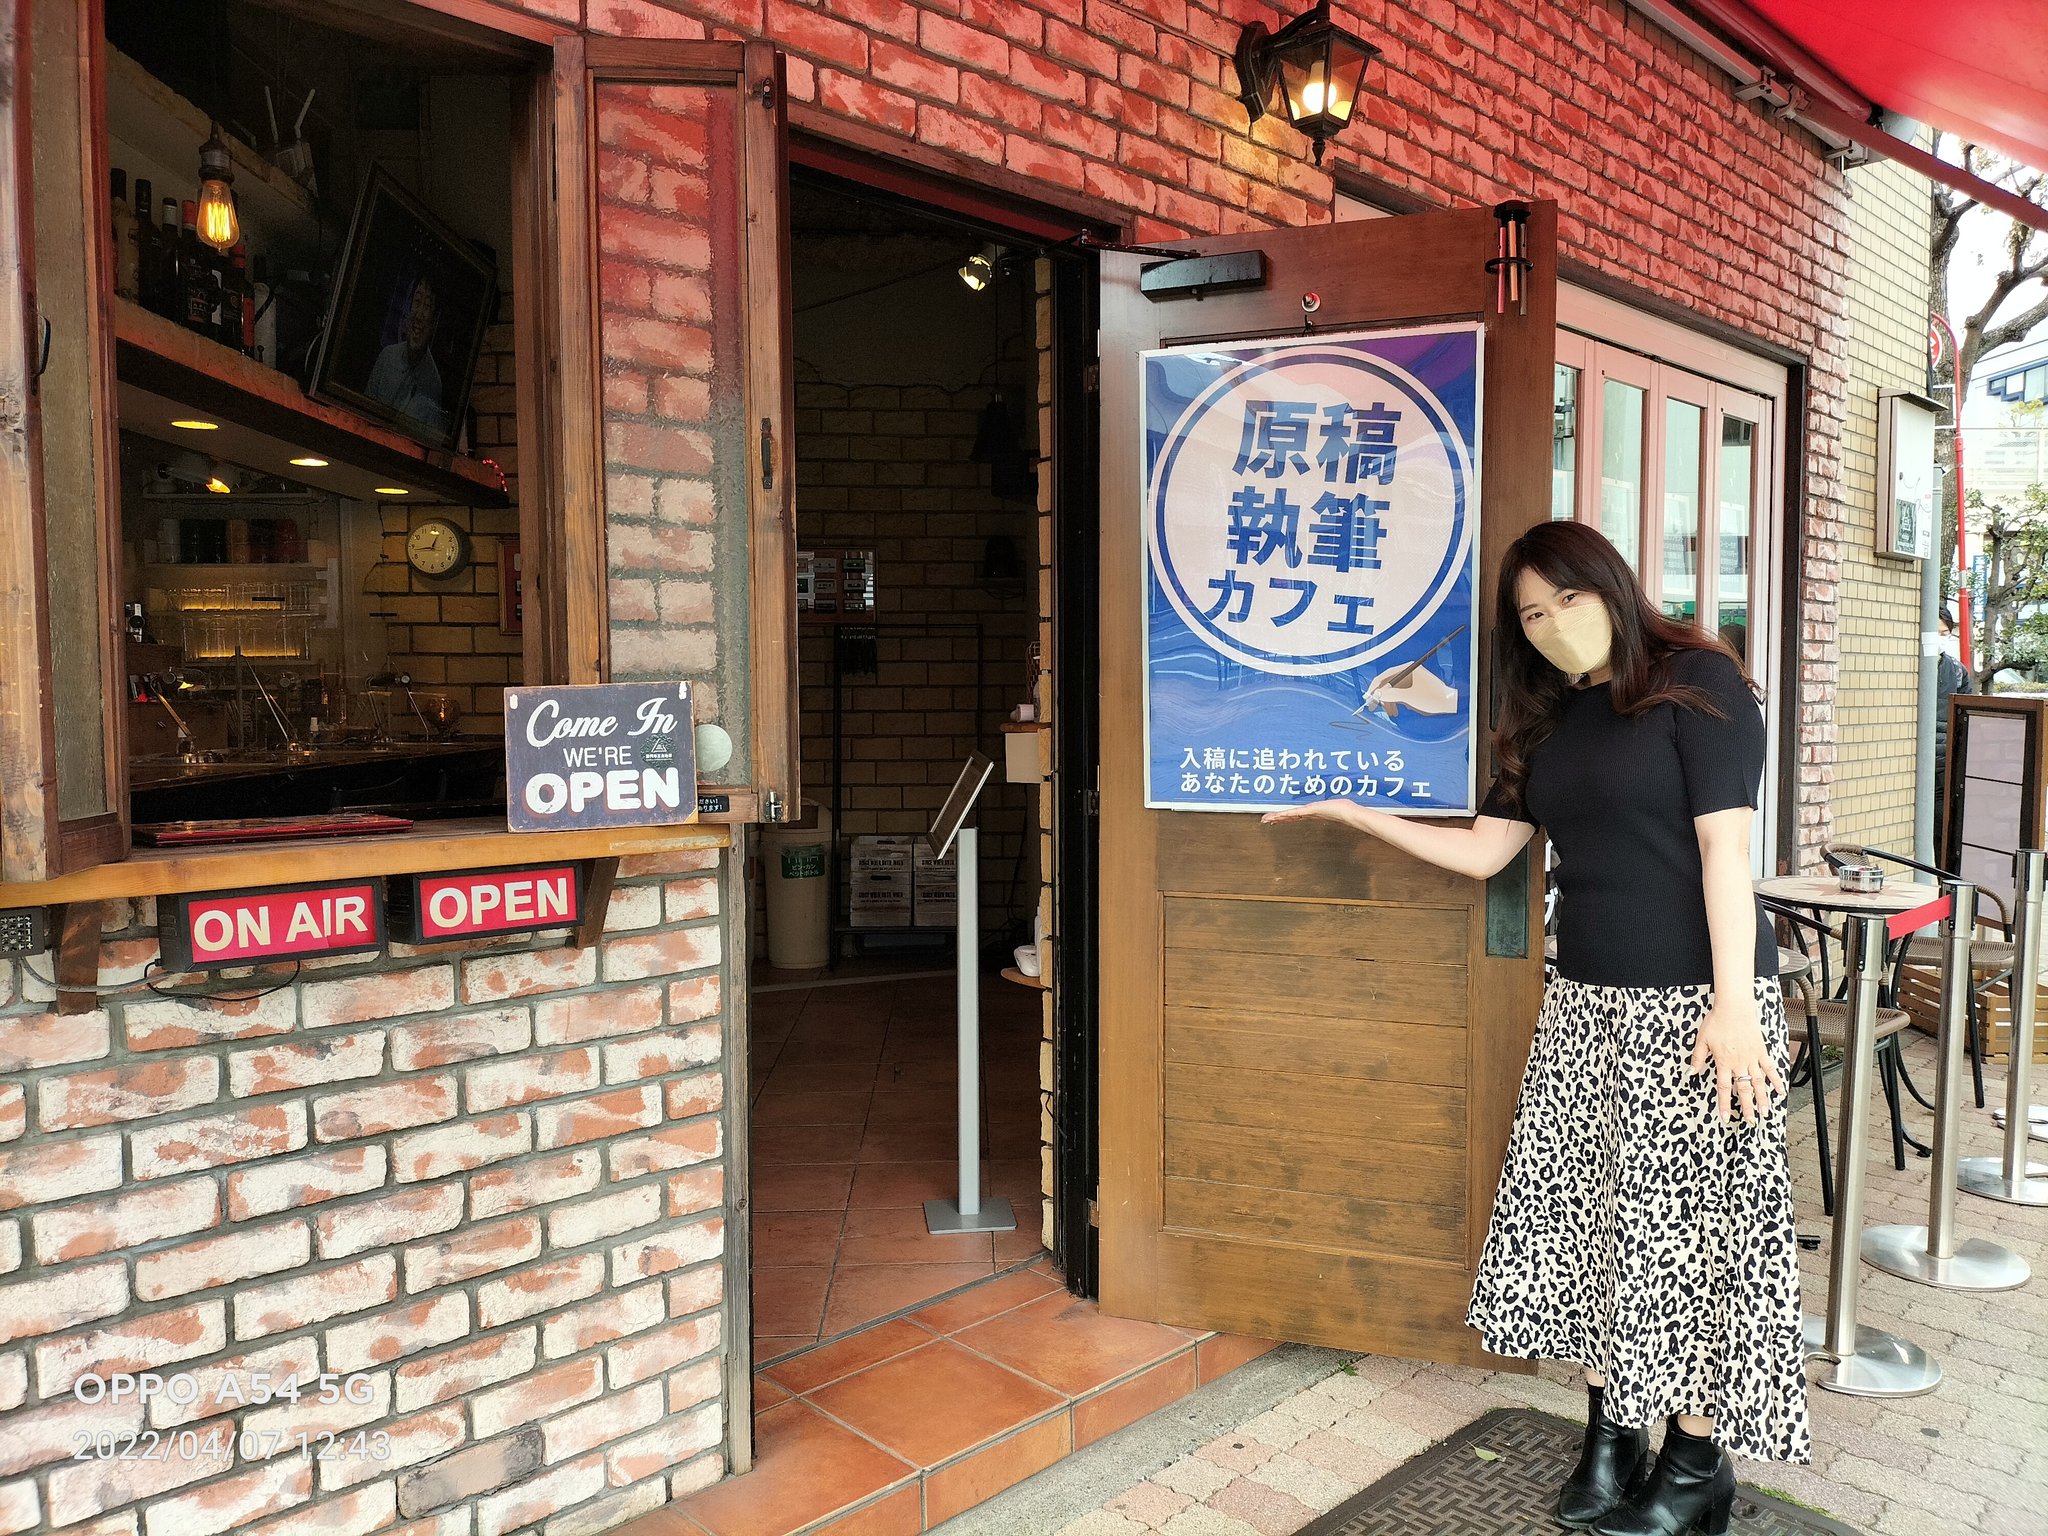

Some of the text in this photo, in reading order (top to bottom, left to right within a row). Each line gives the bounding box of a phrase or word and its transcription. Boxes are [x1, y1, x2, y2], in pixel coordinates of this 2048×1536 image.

[1232, 399, 1403, 486] 原稿
[1226, 485, 1390, 573] 執筆
[1204, 569, 1375, 635] カフェ
[526, 697, 678, 748] Come In
[563, 745, 633, 767] WE'RE
[1179, 747, 1405, 772] 入稿に追われている
[524, 767, 680, 815] OPEN
[1180, 773, 1432, 798] あなたのためのカフェ
[193, 896, 368, 952] ON AIR
[429, 878, 568, 928] OPEN
